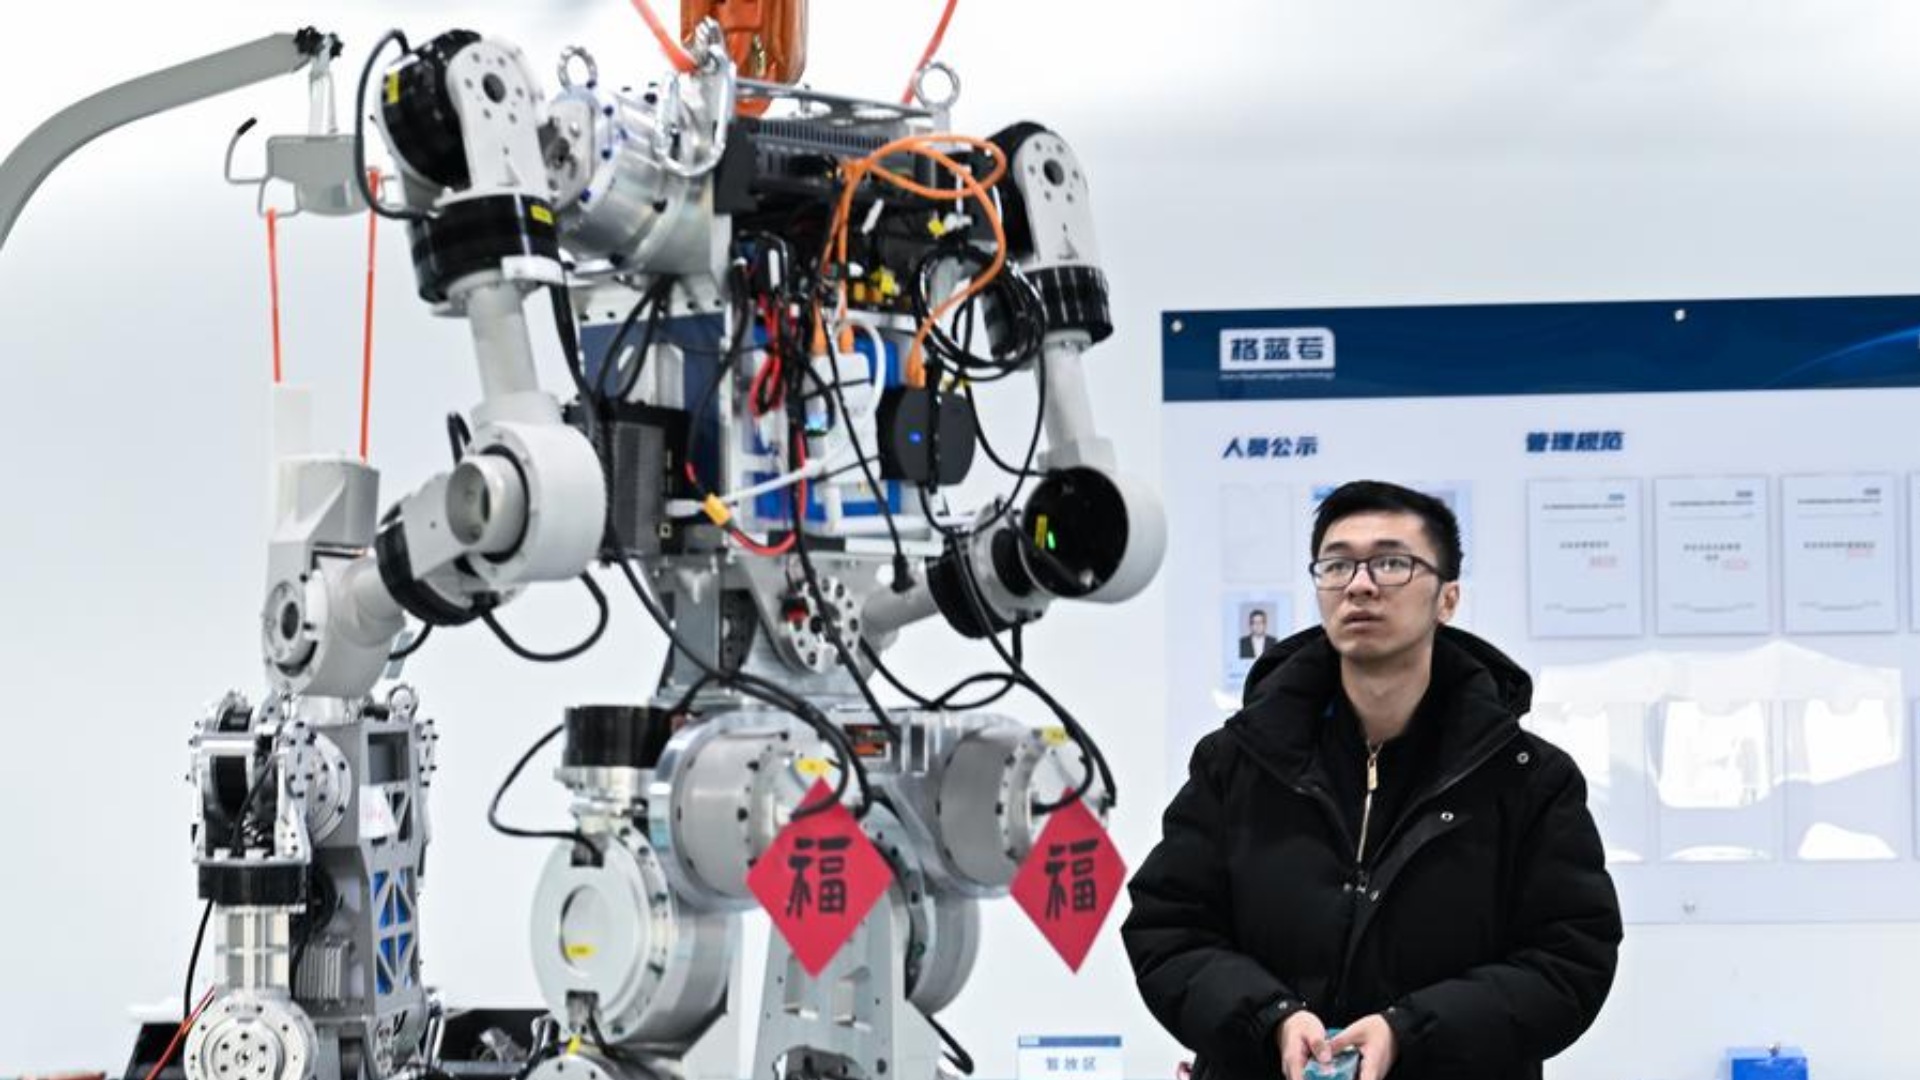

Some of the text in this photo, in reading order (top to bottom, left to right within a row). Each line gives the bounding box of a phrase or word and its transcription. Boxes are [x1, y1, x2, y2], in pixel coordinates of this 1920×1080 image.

[1230, 336, 1324, 361] 格蓝若
[1222, 435, 1318, 459] 人员公示
[1525, 431, 1625, 453] 管理规范
[785, 836, 854, 920] 福
[1044, 838, 1099, 921] 福
